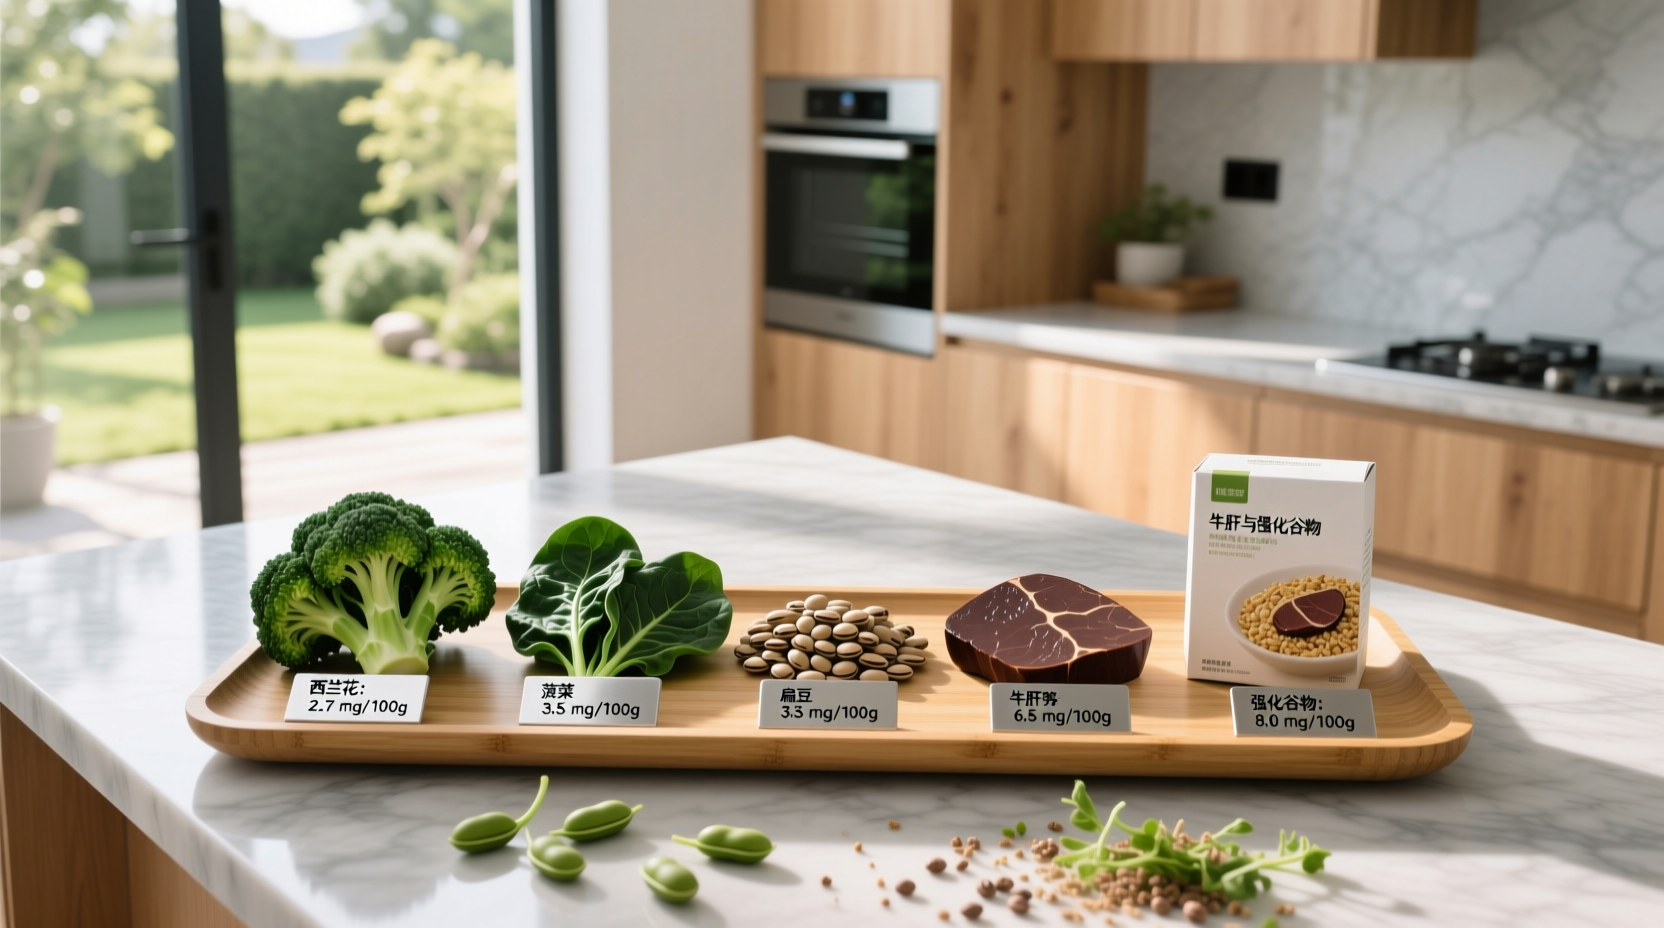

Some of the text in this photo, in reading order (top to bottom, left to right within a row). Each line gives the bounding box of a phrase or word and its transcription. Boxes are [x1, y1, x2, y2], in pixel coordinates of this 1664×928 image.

[780, 687, 813, 703] 扁豆
[308, 699, 408, 717] 2.7 mg/100g
[541, 701, 640, 720] 3.5 mg/100g
[780, 704, 878, 723] 3.3 mg/100g
[1013, 708, 1111, 727] 6.5 mg/100g
[1255, 714, 1355, 732] 8.0 mg/100g
